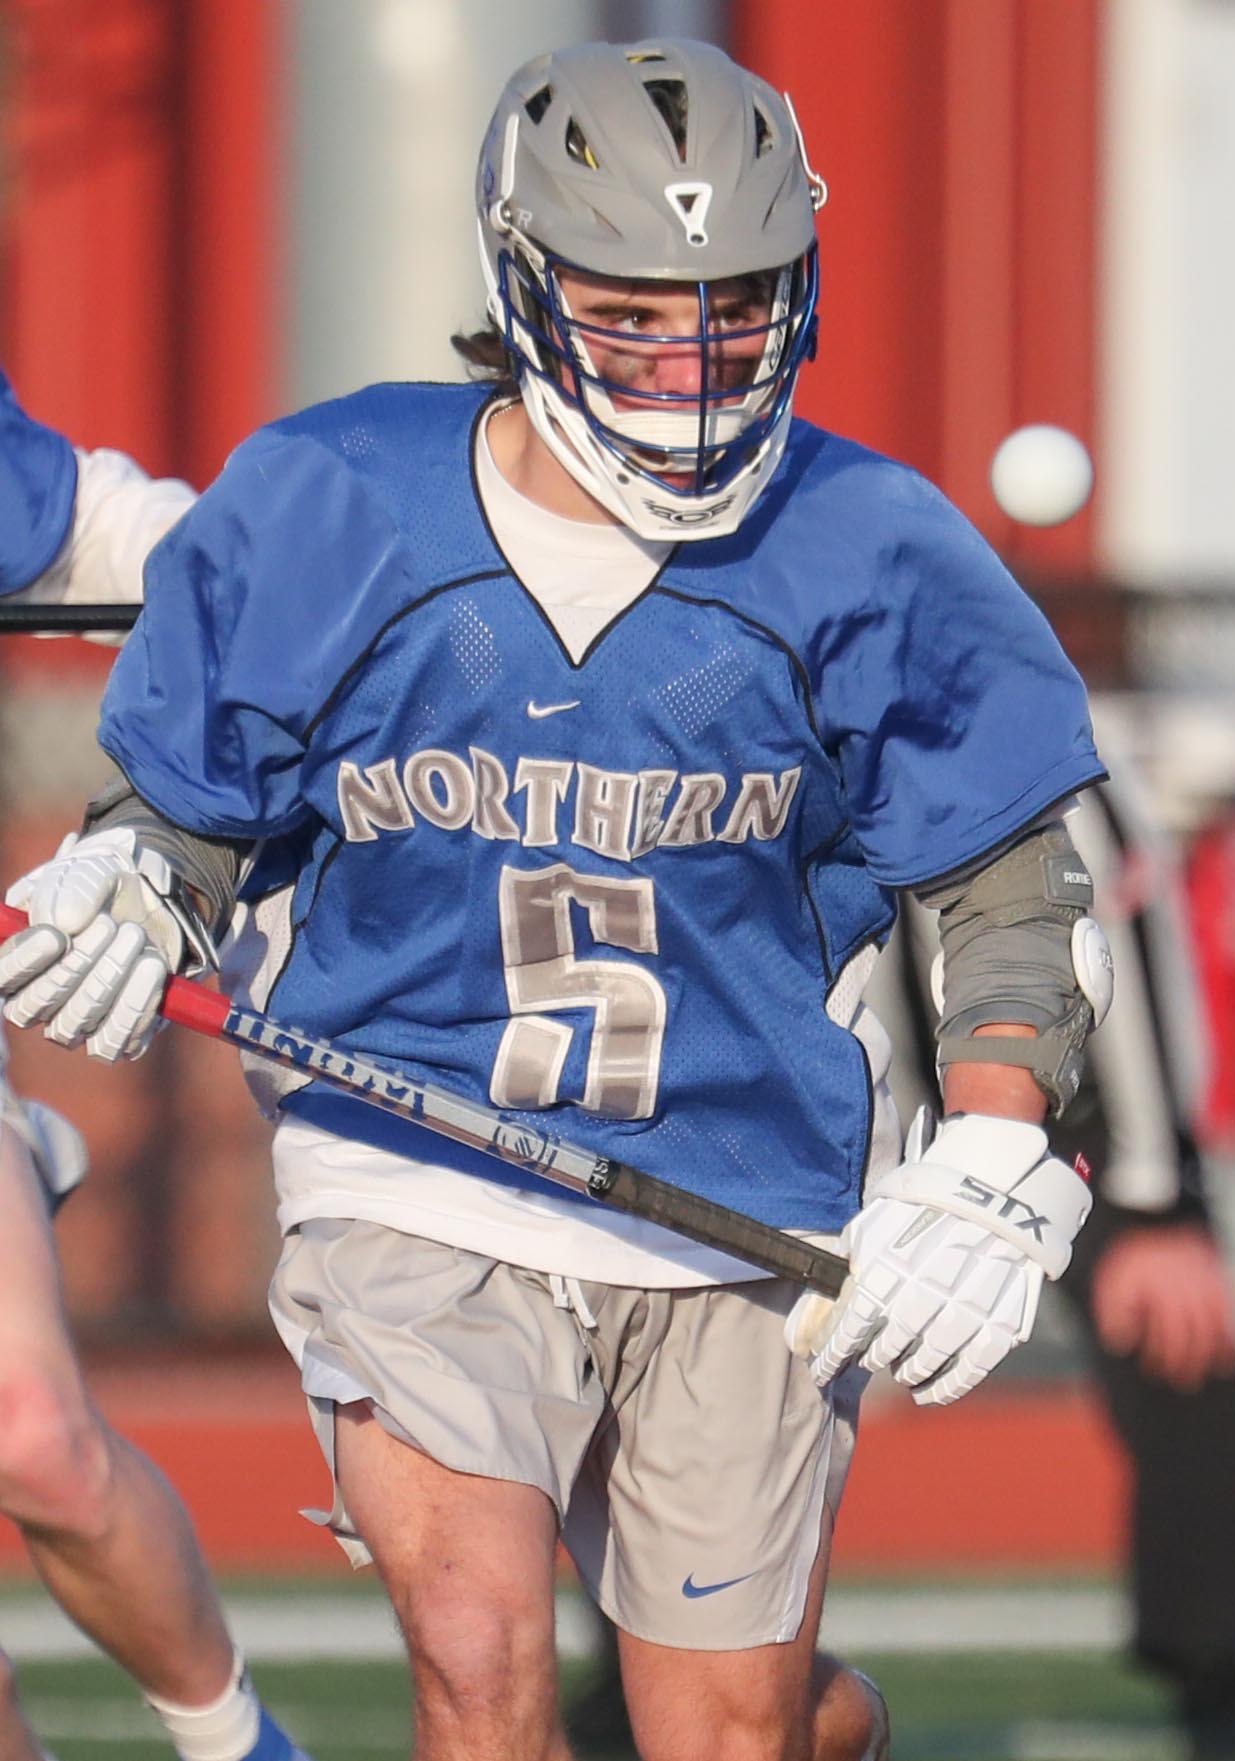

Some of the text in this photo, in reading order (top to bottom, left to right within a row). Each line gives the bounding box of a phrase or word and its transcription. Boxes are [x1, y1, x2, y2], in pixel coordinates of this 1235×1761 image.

[336, 745, 802, 862] NORTHERN
[489, 862, 667, 1121] 5
[951, 1175, 1053, 1246] STX
